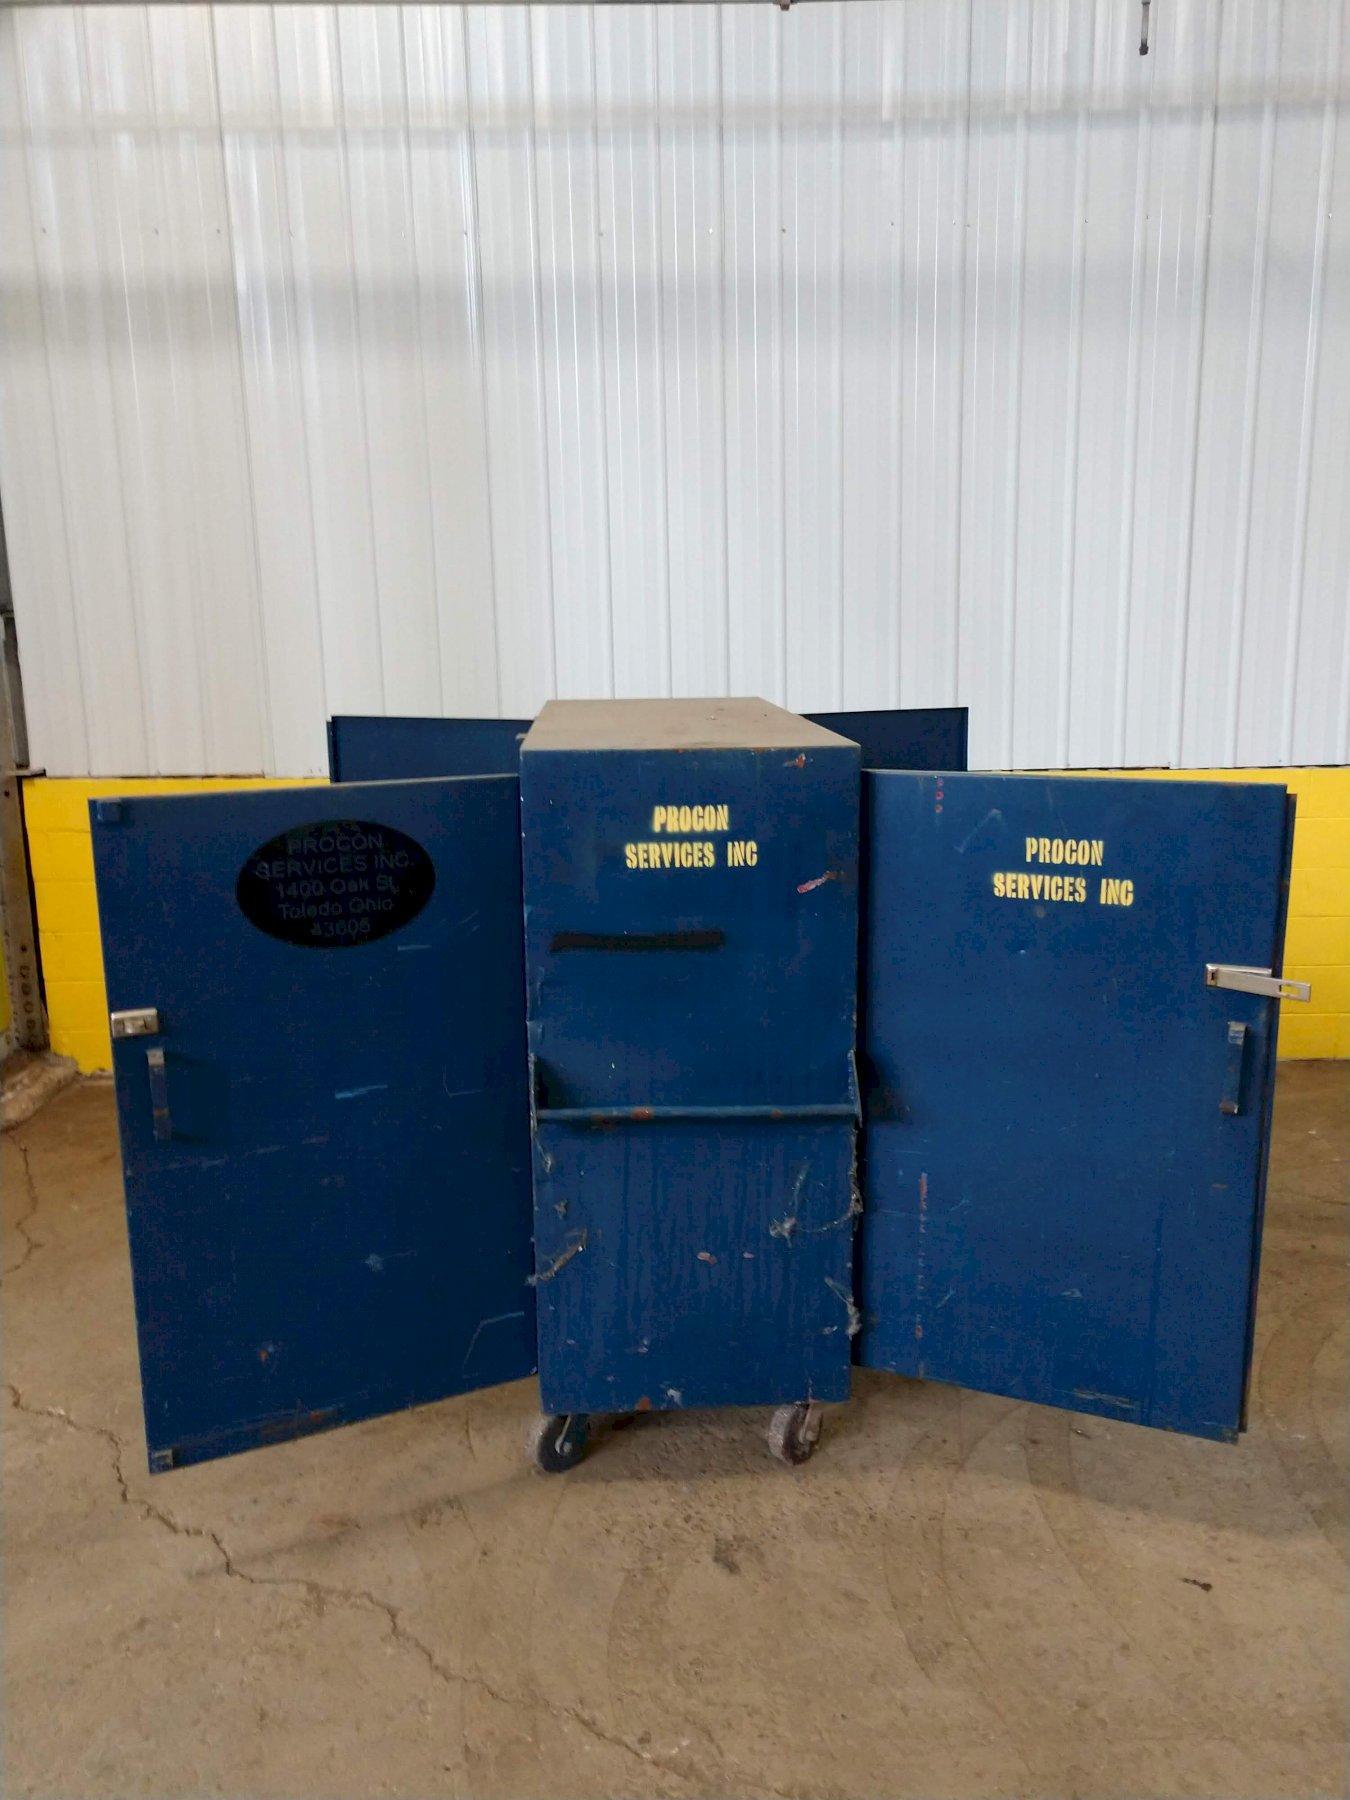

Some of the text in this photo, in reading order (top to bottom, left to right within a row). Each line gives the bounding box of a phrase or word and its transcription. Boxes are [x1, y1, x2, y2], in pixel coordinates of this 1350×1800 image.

[653, 804, 728, 833] PROCON
[286, 833, 383, 855] PROCON
[625, 840, 758, 869] SERVICES INC
[1025, 837, 1104, 866] PROCON
[255, 853, 368, 880] SERVICES
[993, 872, 1134, 907] SERVICES INC
[279, 897, 394, 920] Toledo Ohio
